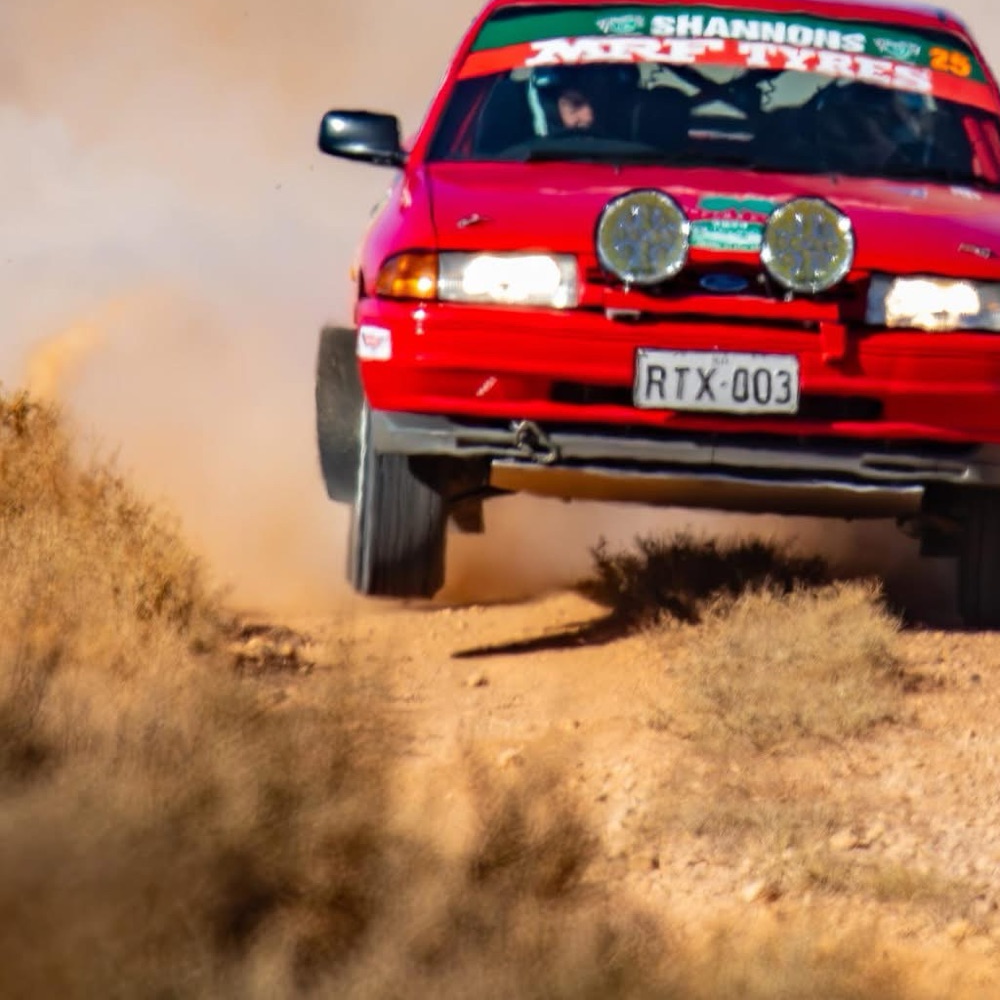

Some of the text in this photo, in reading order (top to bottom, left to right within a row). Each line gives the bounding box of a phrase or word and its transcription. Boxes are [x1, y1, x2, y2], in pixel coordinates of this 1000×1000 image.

[650, 14, 867, 53] SHANNONS
[525, 37, 725, 66] MRF
[737, 41, 933, 92] TYRES
[928, 46, 972, 77] 25
